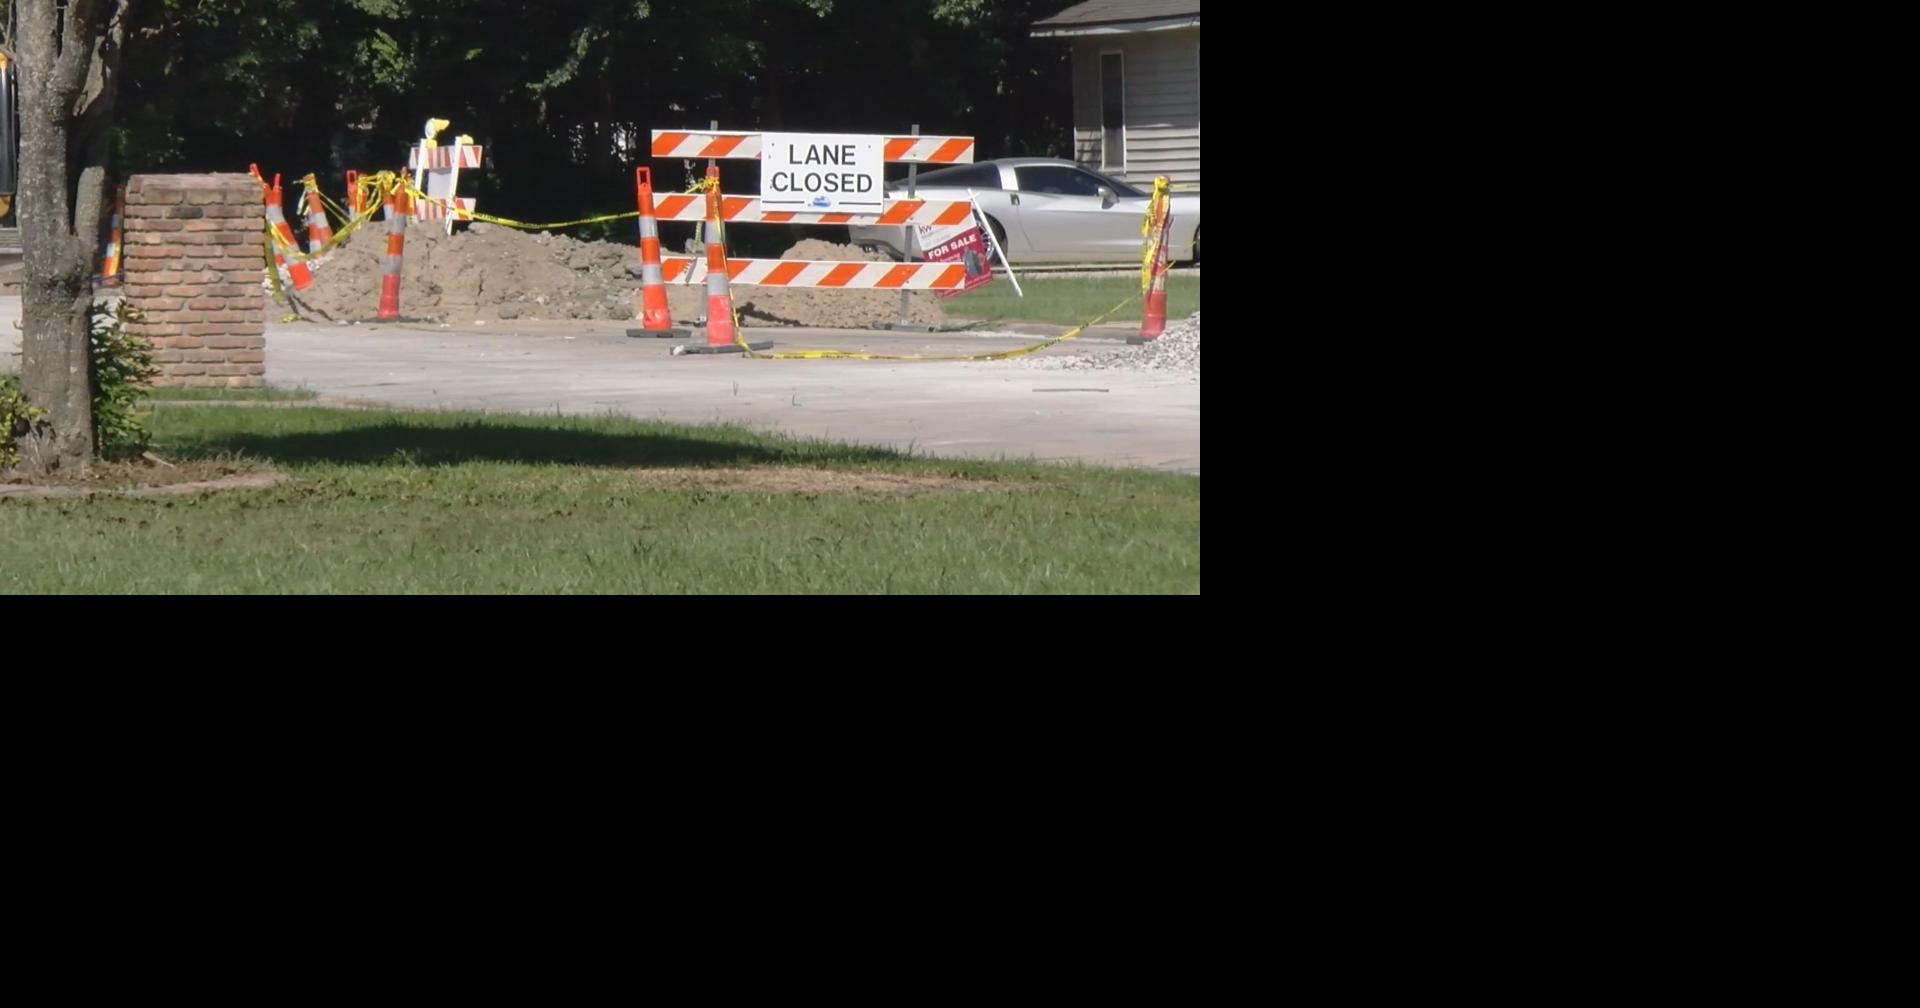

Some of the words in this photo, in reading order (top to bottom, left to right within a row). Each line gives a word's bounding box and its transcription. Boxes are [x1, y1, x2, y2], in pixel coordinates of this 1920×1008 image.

[789, 144, 856, 166] LANE
[771, 171, 873, 193] CLOSED
[928, 245, 950, 260] FOR
[950, 233, 977, 250] SALE
